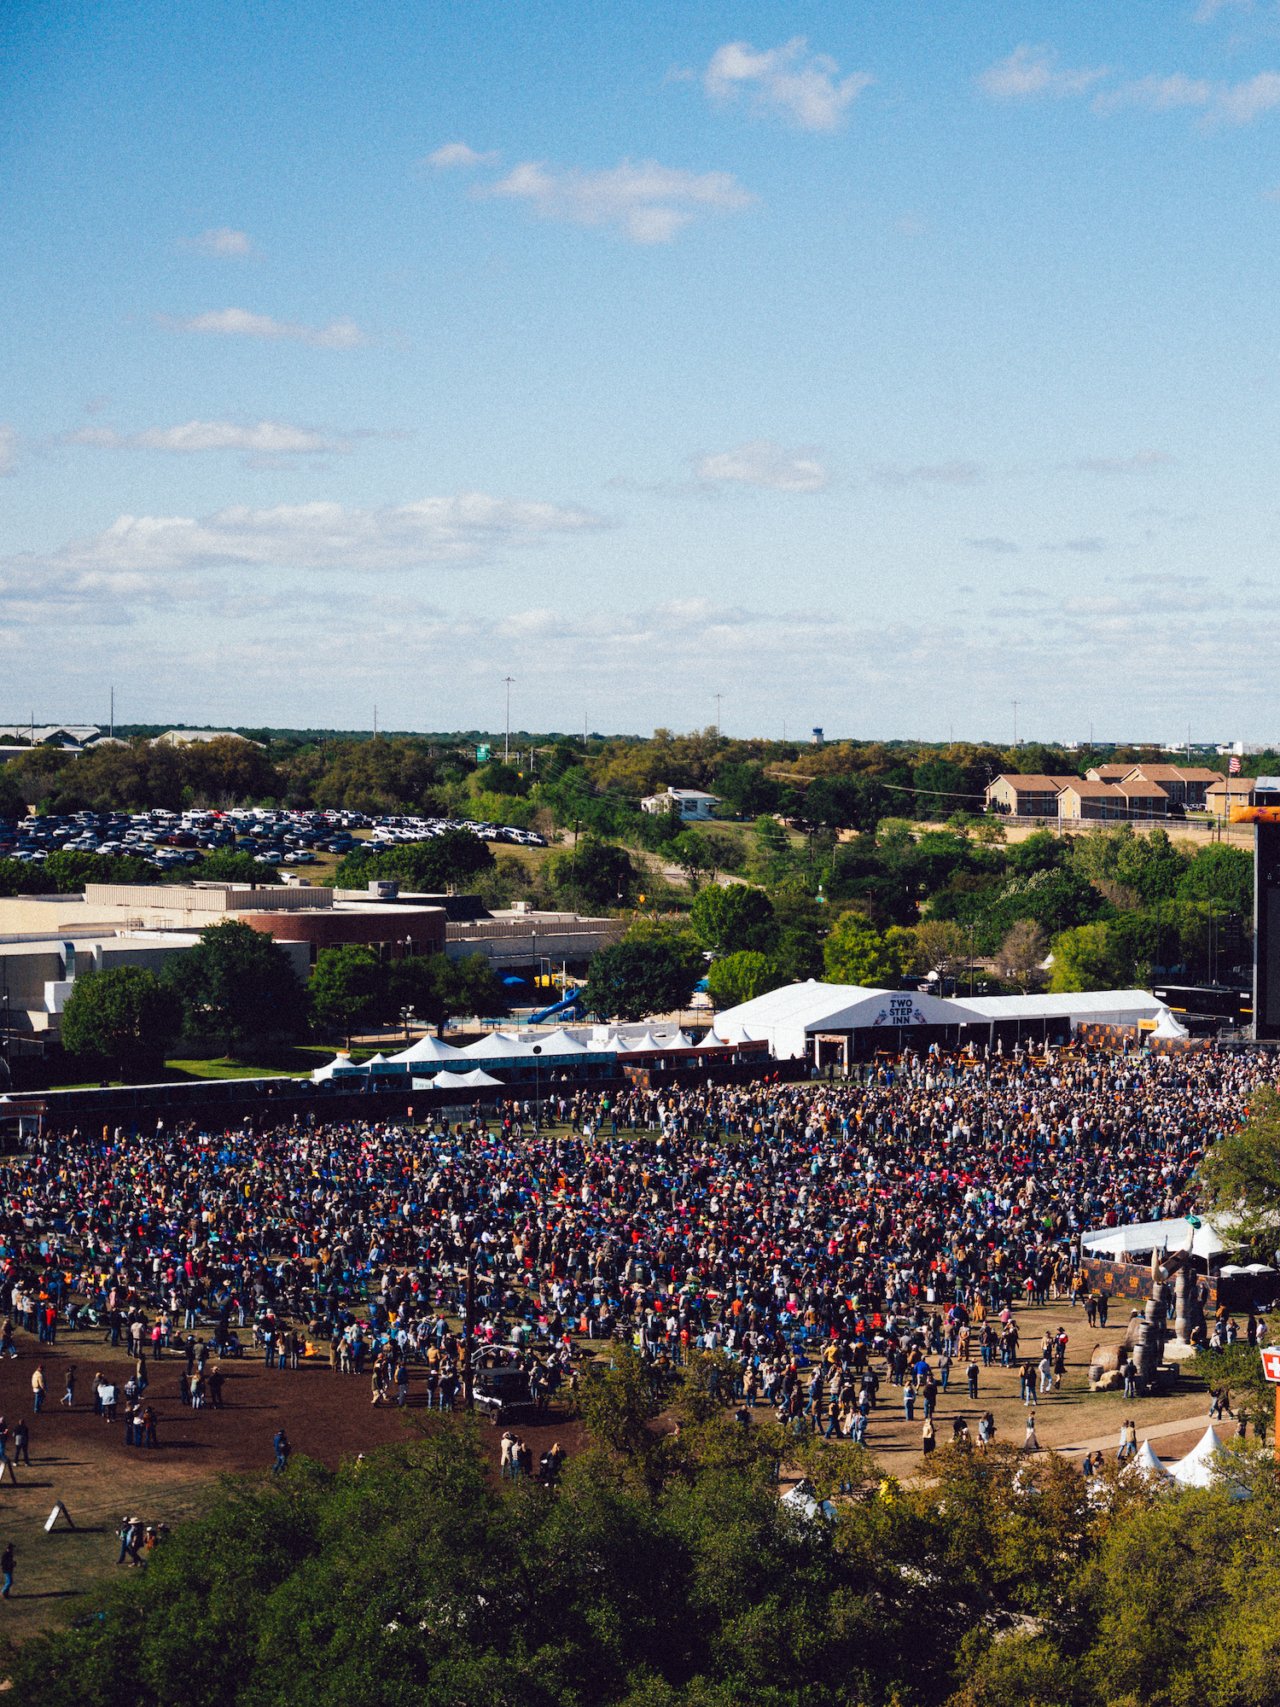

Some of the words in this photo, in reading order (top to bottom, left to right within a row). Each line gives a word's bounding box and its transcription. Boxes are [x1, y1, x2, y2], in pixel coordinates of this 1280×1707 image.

[890, 999, 912, 1007] TWO
[889, 1008, 912, 1016] STEP
[892, 1016, 910, 1024] INN
